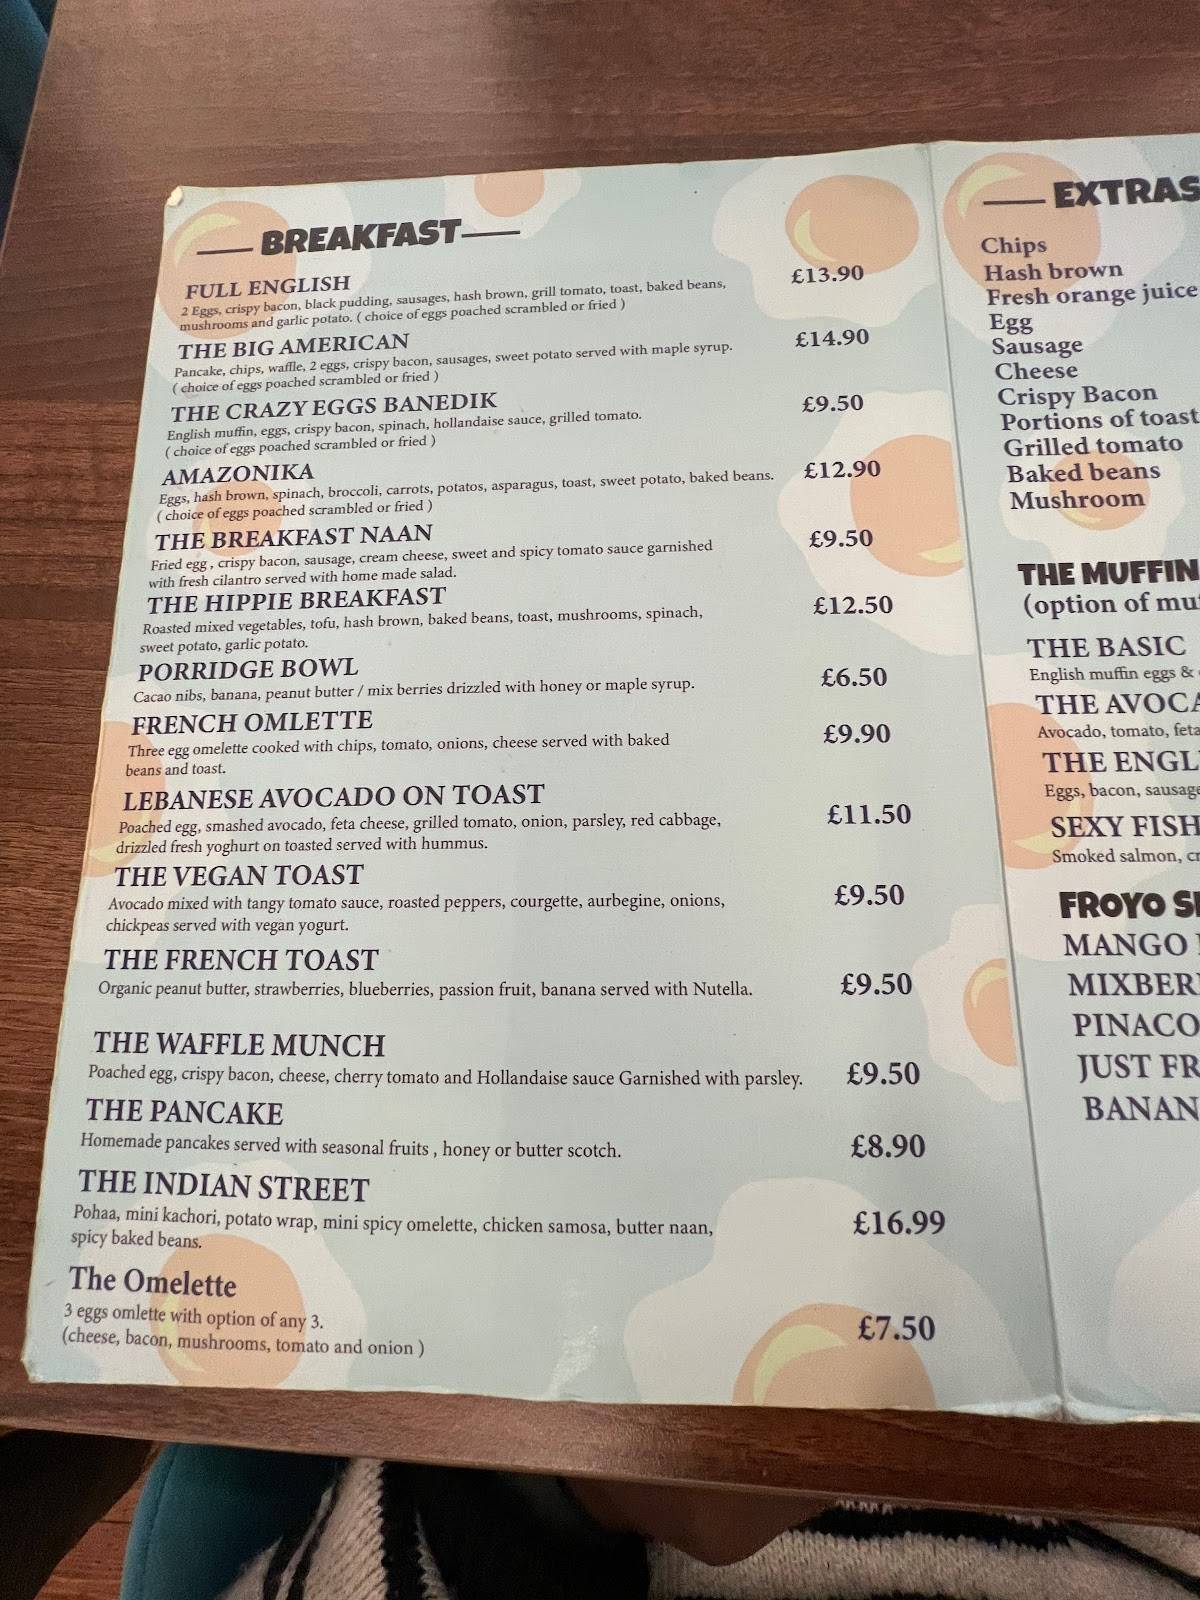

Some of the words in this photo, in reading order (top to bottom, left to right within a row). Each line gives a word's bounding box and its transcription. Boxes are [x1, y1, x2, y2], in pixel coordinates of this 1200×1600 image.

[1053, 175, 1200, 208] EXTRAS
[260, 218, 462, 256] BREAKFAST
[981, 237, 1048, 258] Chips
[791, 265, 864, 284] £13.90
[984, 263, 1043, 282] Hash
[1047, 262, 1124, 279] brown
[181, 307, 188, 316] 2
[191, 306, 222, 318] Eggs,
[225, 304, 260, 316] crispy
[263, 301, 301, 312] bacon,
[305, 298, 336, 310] black
[339, 296, 392, 311] pudding,
[396, 295, 450, 306] sausages,
[454, 290, 482, 302] hash
[485, 289, 528, 300] brown,
[531, 286, 556, 301] grill
[560, 286, 606, 296] tomato,
[610, 284, 643, 294] toast,
[646, 279, 684, 292] baked
[687, 279, 726, 290] beans,
[185, 282, 242, 300] FULL
[247, 275, 351, 296] ENGLISH
[986, 287, 1050, 306] Fresh
[1056, 288, 1136, 307] orange
[1142, 282, 1198, 306] juice
[988, 313, 1034, 335] Egg
[178, 343, 227, 360] THE
[232, 340, 275, 357] BIG
[278, 333, 410, 355] AMERICAN
[795, 328, 869, 348] £14.90
[992, 337, 1084, 359] Sausage
[995, 362, 1078, 380] Cheese
[171, 405, 220, 423] THE
[225, 400, 309, 420] CRAZY
[311, 397, 377, 416] EGGS
[383, 392, 498, 413] BANEDIK
[802, 394, 864, 413] £9.50
[997, 387, 1076, 410] Crispy
[1081, 385, 1159, 403] Bacon
[1000, 412, 1103, 431] Portions
[1109, 408, 1135, 428] of
[1003, 436, 1091, 457] Grilled
[1095, 435, 1184, 454] tomato
[161, 463, 315, 486] AMAZONIKA
[804, 460, 881, 479] £12.90
[1006, 463, 1084, 483] Baked
[1087, 462, 1161, 481] beans
[1009, 489, 1146, 510] Mushroom
[155, 532, 205, 551] THE
[210, 527, 355, 549] BREAKFAST
[359, 524, 433, 544] NAAN
[809, 529, 873, 548] £9.50
[1017, 562, 1075, 586] THE
[1081, 558, 1200, 585] MUFFIN
[147, 595, 198, 615] THE
[204, 592, 293, 612] HIPPIE
[298, 586, 447, 610] BREAKFAST
[813, 595, 893, 615] £12.50
[1024, 593, 1118, 620] (option
[1124, 591, 1151, 613] of
[1026, 638, 1090, 658] THE
[1095, 635, 1187, 657] BASIC
[137, 660, 274, 682] PORRIDGE
[279, 657, 359, 678] BOWL
[821, 667, 887, 687] £6.50
[1029, 667, 1086, 685] English
[1089, 666, 1139, 680] muffin
[1143, 669, 1176, 683] eggs
[133, 691, 172, 703] Cacao
[175, 689, 206, 703] nibs,
[211, 688, 261, 701] banana,
[265, 688, 311, 703] peanut
[315, 685, 355, 698] butter
[367, 684, 394, 696] mix
[397, 683, 443, 696] berries
[446, 680, 501, 694] drizzled
[505, 680, 536, 693] with
[540, 679, 583, 695] honey
[586, 682, 602, 691] or
[605, 677, 647, 694] maple
[651, 680, 695, 693] syrup.
[1035, 694, 1099, 715] THE
[131, 714, 239, 736] FRENCH
[244, 710, 373, 732] OMLETTE
[823, 723, 891, 744] £9.90
[1037, 724, 1106, 739] Avocado,
[1110, 725, 1169, 738] tomato,
[1042, 752, 1107, 773] THE
[122, 789, 254, 811] LEBANESE
[258, 786, 396, 809] AVOCADO
[403, 785, 446, 806] ON
[452, 783, 545, 805] TOAST
[1044, 784, 1086, 802] Eggs,
[1088, 782, 1141, 798] bacon,
[827, 803, 911, 825] £11.50
[1051, 815, 1125, 838] SEXY
[1052, 848, 1116, 863] Smoked
[1119, 847, 1182, 864] salmon,
[114, 866, 167, 887] THE
[172, 865, 269, 887] VEGAN
[273, 864, 365, 886] TOAST
[834, 884, 905, 906] £9.50
[1059, 890, 1167, 919] FROYO
[106, 917, 170, 936] chickpeas
[173, 917, 217, 932] served
[221, 917, 251, 931] with
[255, 921, 294, 936] vegan
[298, 919, 349, 936] yogurt.
[1062, 932, 1188, 956] MANGO
[104, 949, 158, 970] THE
[164, 949, 279, 971] FRENCH
[285, 948, 380, 971] TOAST
[98, 980, 152, 999] Organic
[155, 983, 202, 999] peanut
[206, 980, 250, 997] butter,
[254, 981, 344, 998] strawberries,
[349, 981, 434, 998] blueberries,
[439, 982, 494, 1001] passion
[499, 981, 536, 998] fruit,
[540, 981, 596, 996] banana
[600, 980, 650, 997] served
[654, 980, 688, 996] with
[692, 980, 753, 996] Nutella.
[840, 972, 913, 996] £9.50
[94, 1031, 149, 1054] THE
[156, 1032, 265, 1056] WAFFLE
[270, 1033, 386, 1057] MUNCH
[846, 1061, 920, 1086] £9.50
[1077, 1053, 1152, 1084] JUST
[85, 1098, 143, 1122] THE
[149, 1100, 284, 1126] PANCAKE
[850, 1134, 926, 1159] £8.90
[78, 1169, 137, 1194] THE
[143, 1173, 252, 1199] INDIAN
[258, 1175, 370, 1202] STREET
[853, 1210, 946, 1236] £16.99
[70, 1229, 108, 1249] spicy
[111, 1228, 154, 1246] baked
[158, 1230, 202, 1249] beans.
[69, 1265, 116, 1291] The
[123, 1268, 237, 1298] Omelette
[858, 1315, 936, 1341] £7.50
